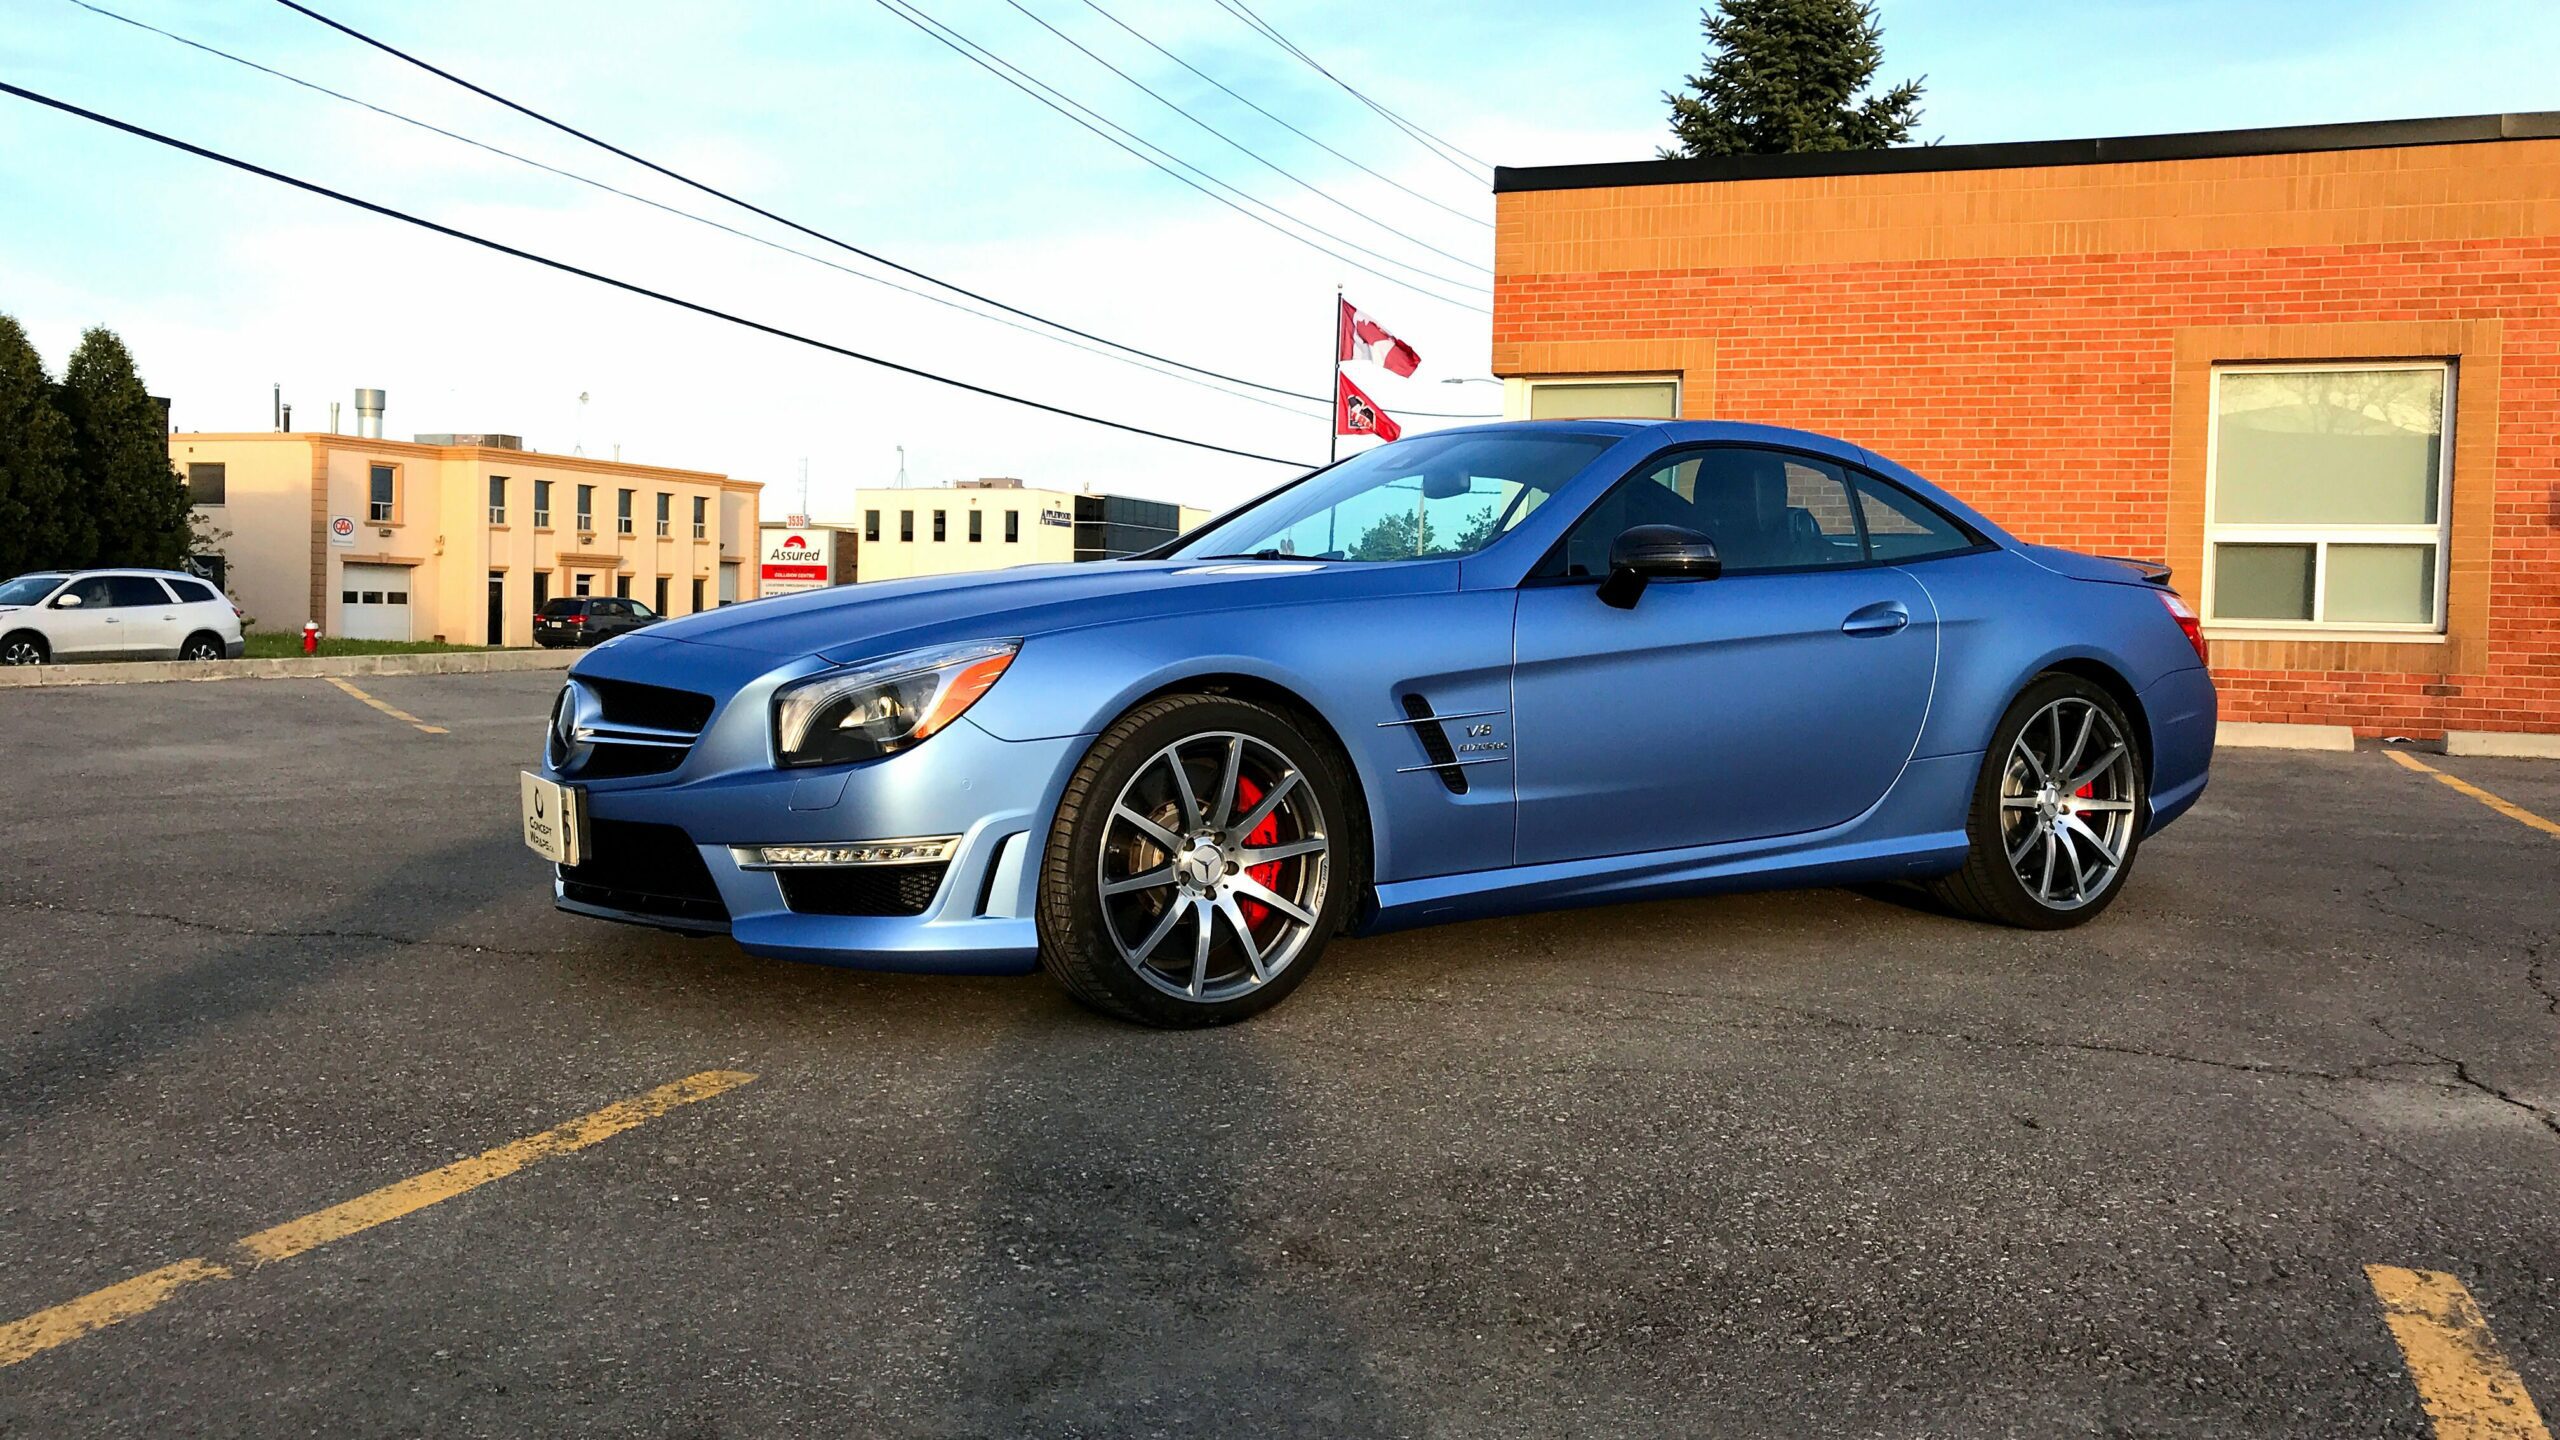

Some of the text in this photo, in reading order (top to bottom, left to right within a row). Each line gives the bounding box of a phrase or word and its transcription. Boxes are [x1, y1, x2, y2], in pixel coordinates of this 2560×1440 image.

[788, 516, 803, 526] 3535
[770, 548, 820, 561] Assured
[1466, 724, 1492, 737] V8
